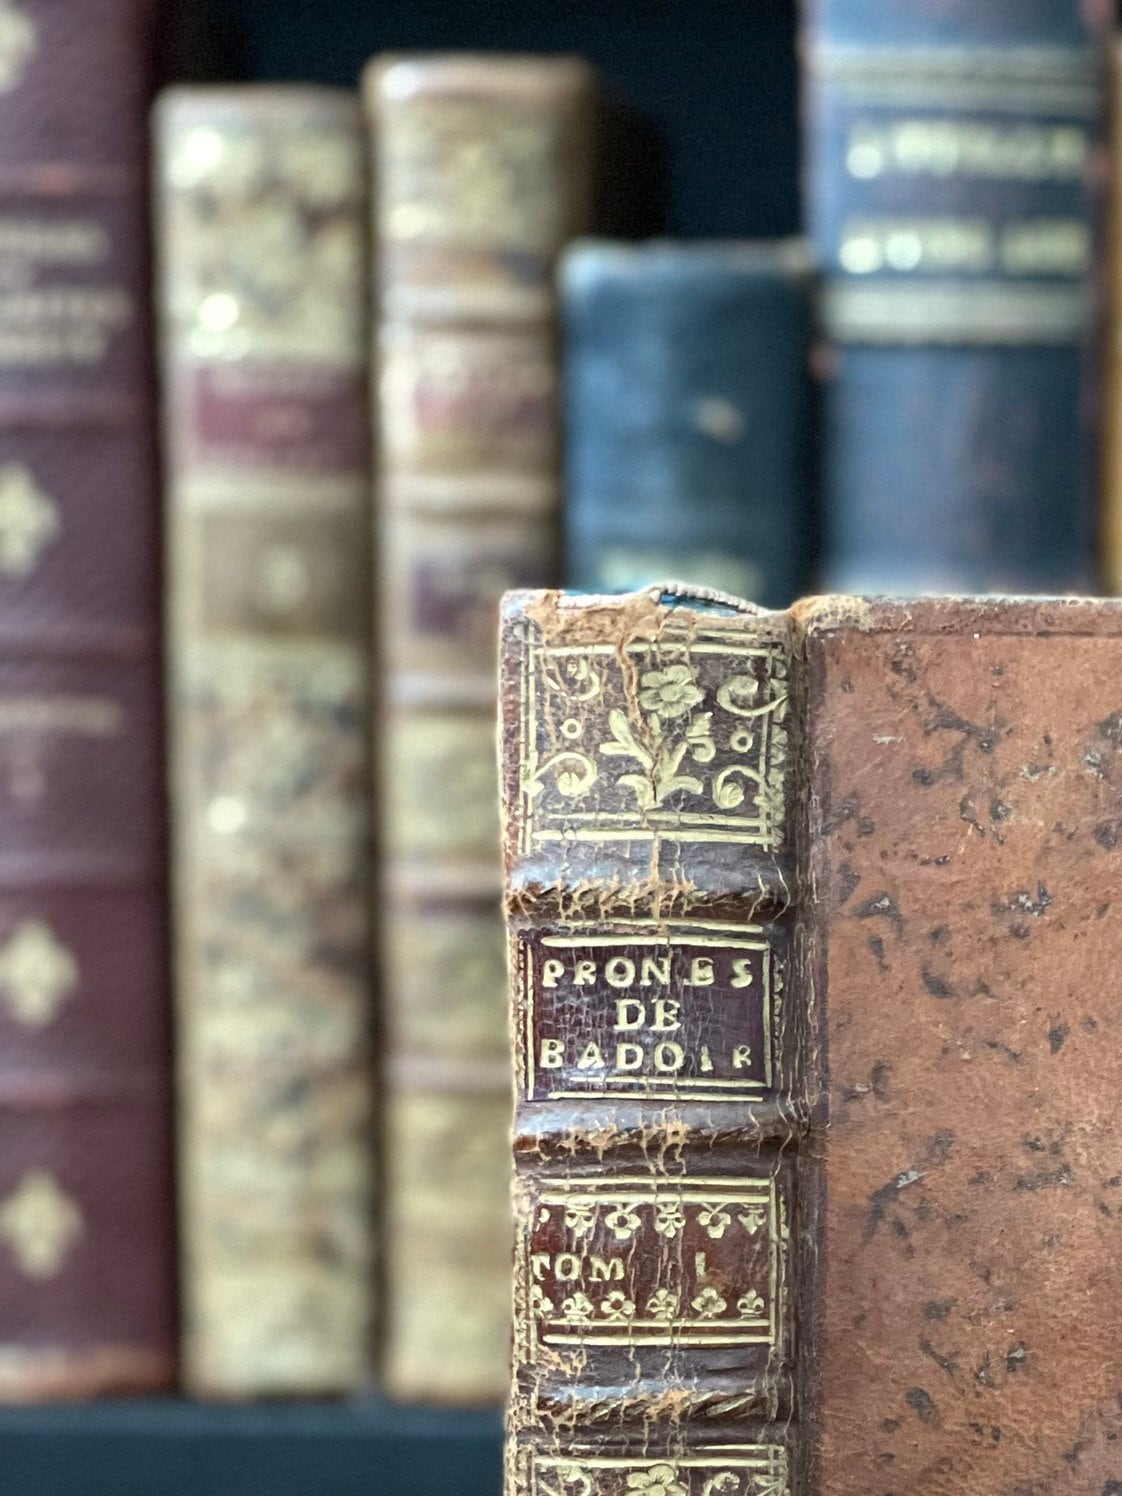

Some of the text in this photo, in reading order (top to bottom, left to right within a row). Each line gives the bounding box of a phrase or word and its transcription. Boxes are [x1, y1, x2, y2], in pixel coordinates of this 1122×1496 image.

[541, 956, 753, 988] PRONES
[614, 999, 682, 1031] DE
[539, 1039, 751, 1072] BADOIR
